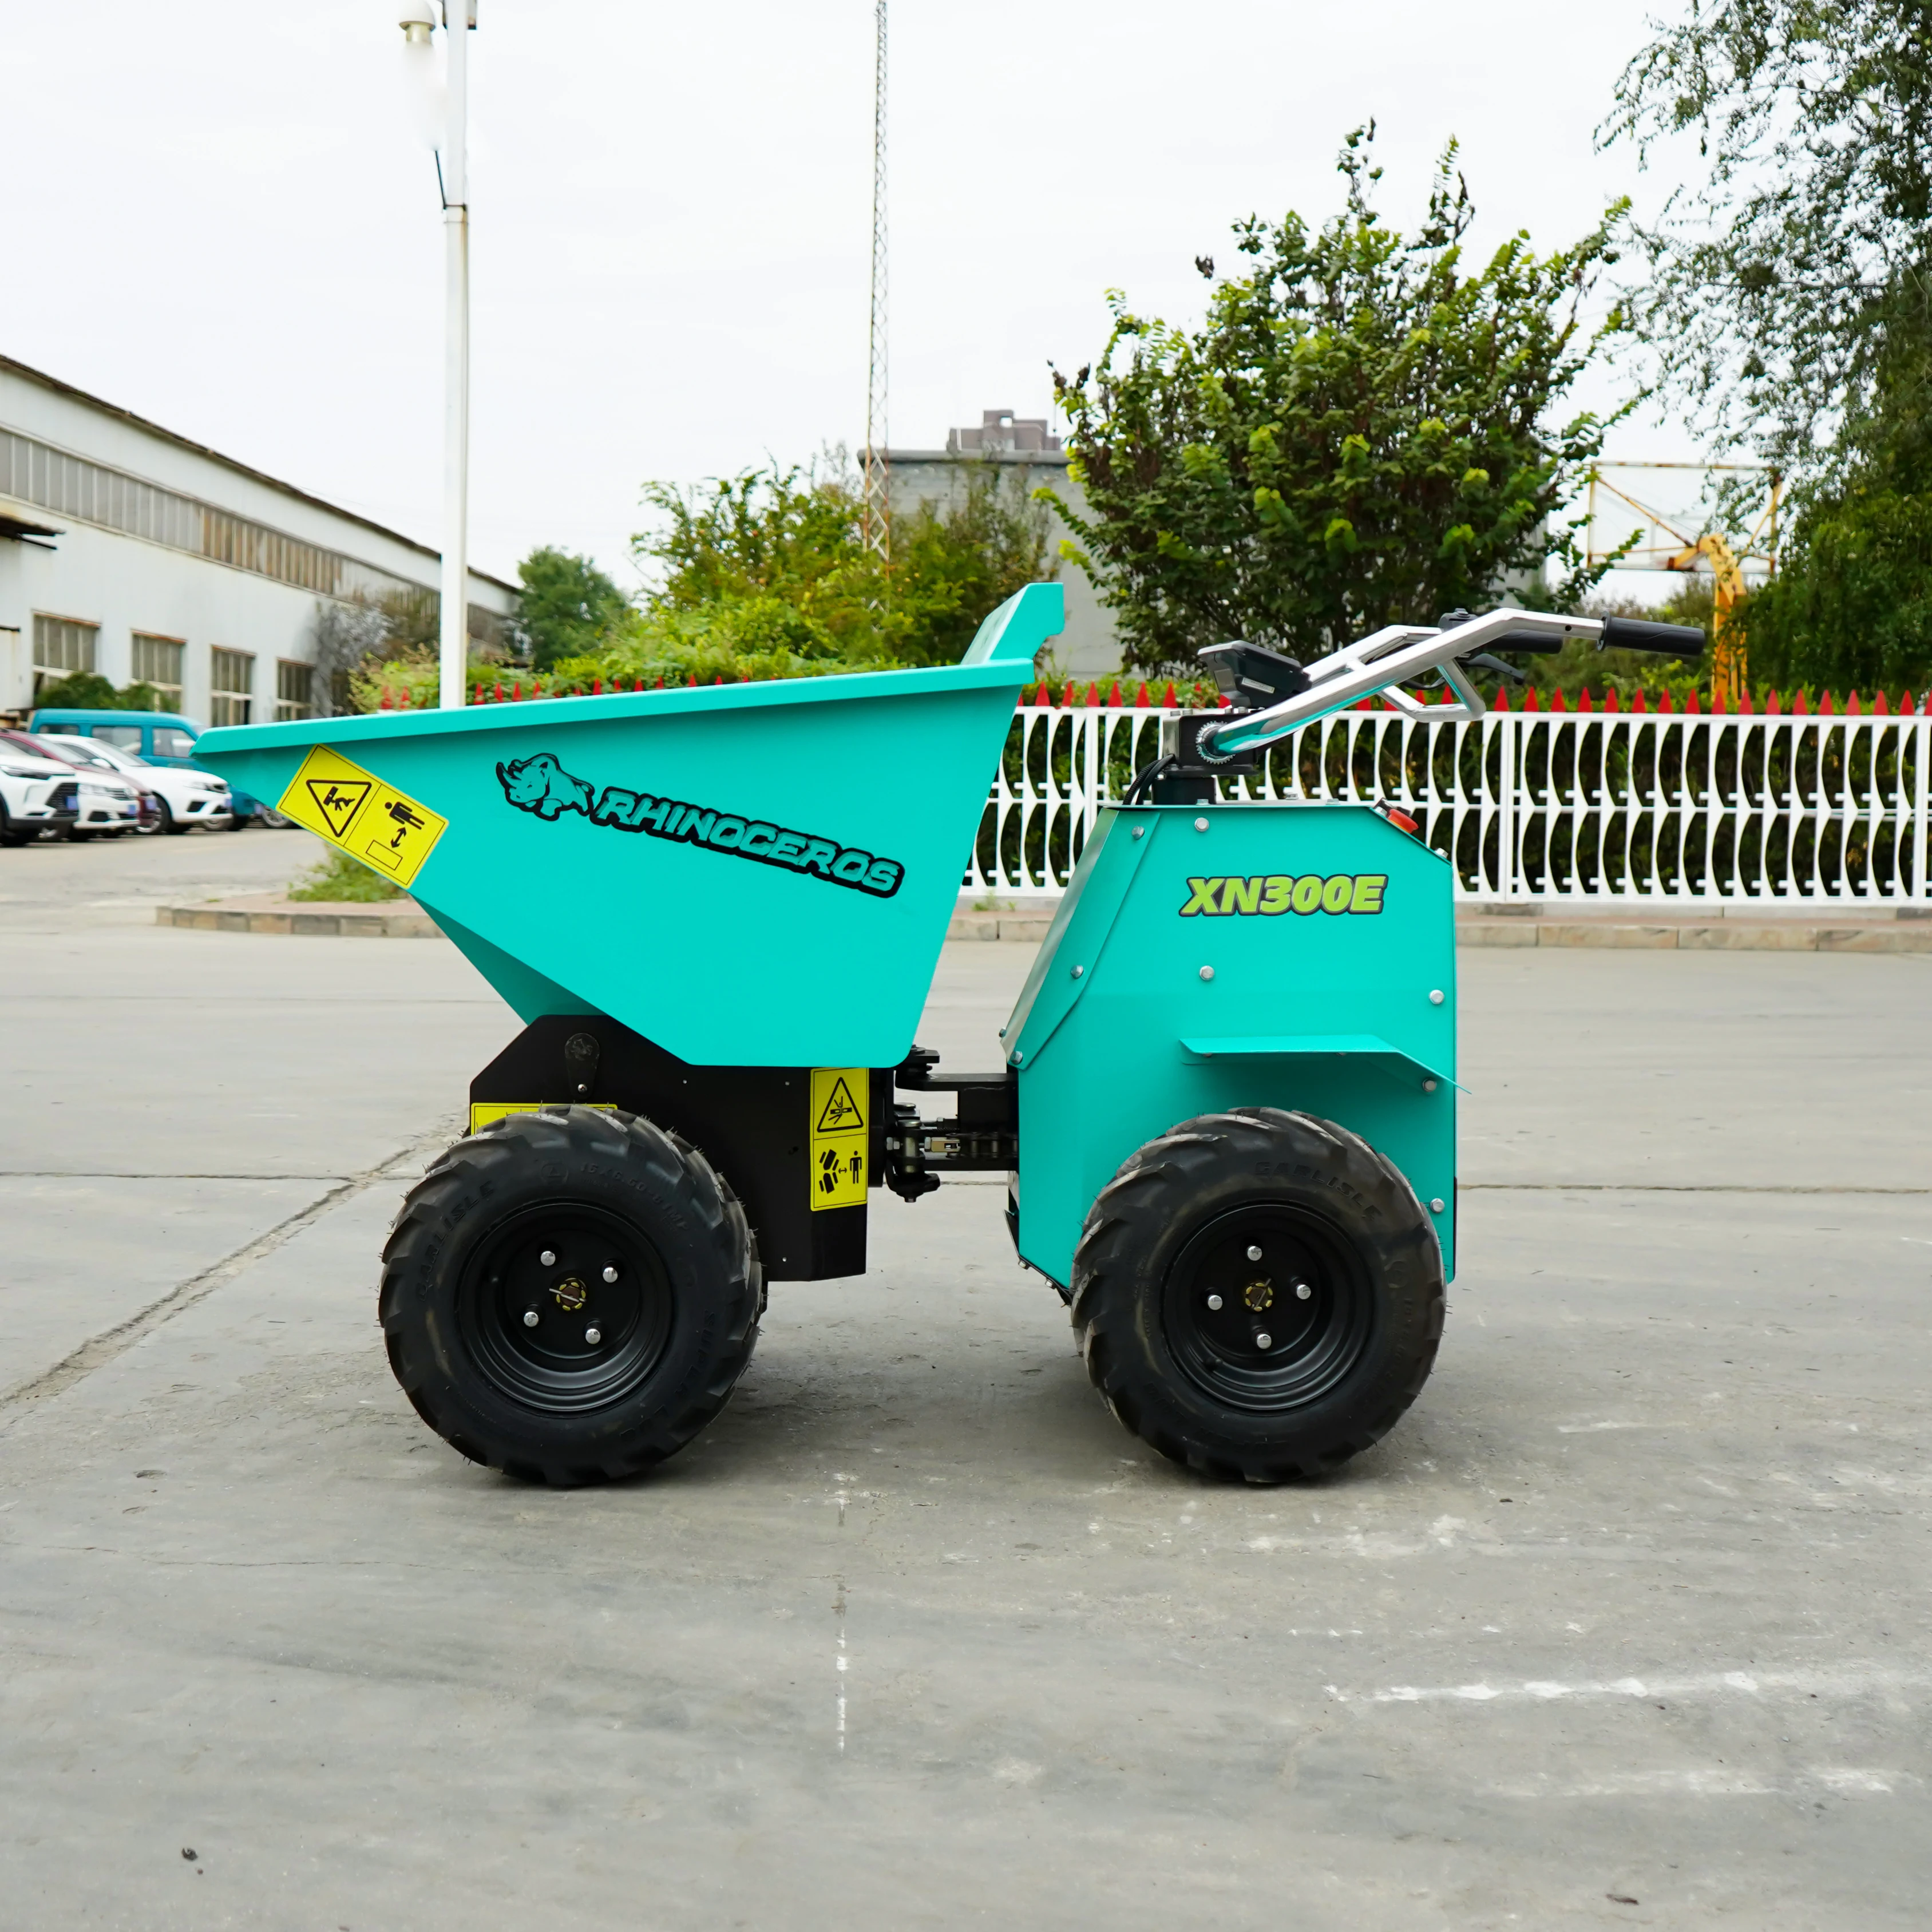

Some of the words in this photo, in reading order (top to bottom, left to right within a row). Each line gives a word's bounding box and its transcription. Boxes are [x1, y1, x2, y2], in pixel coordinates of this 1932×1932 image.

[592, 787, 904, 897] RHINOCEROS
[1179, 874, 1388, 916] XN300E
[1254, 1161, 1384, 1221] CARLISLE
[418, 1180, 494, 1301] CARLISLE
